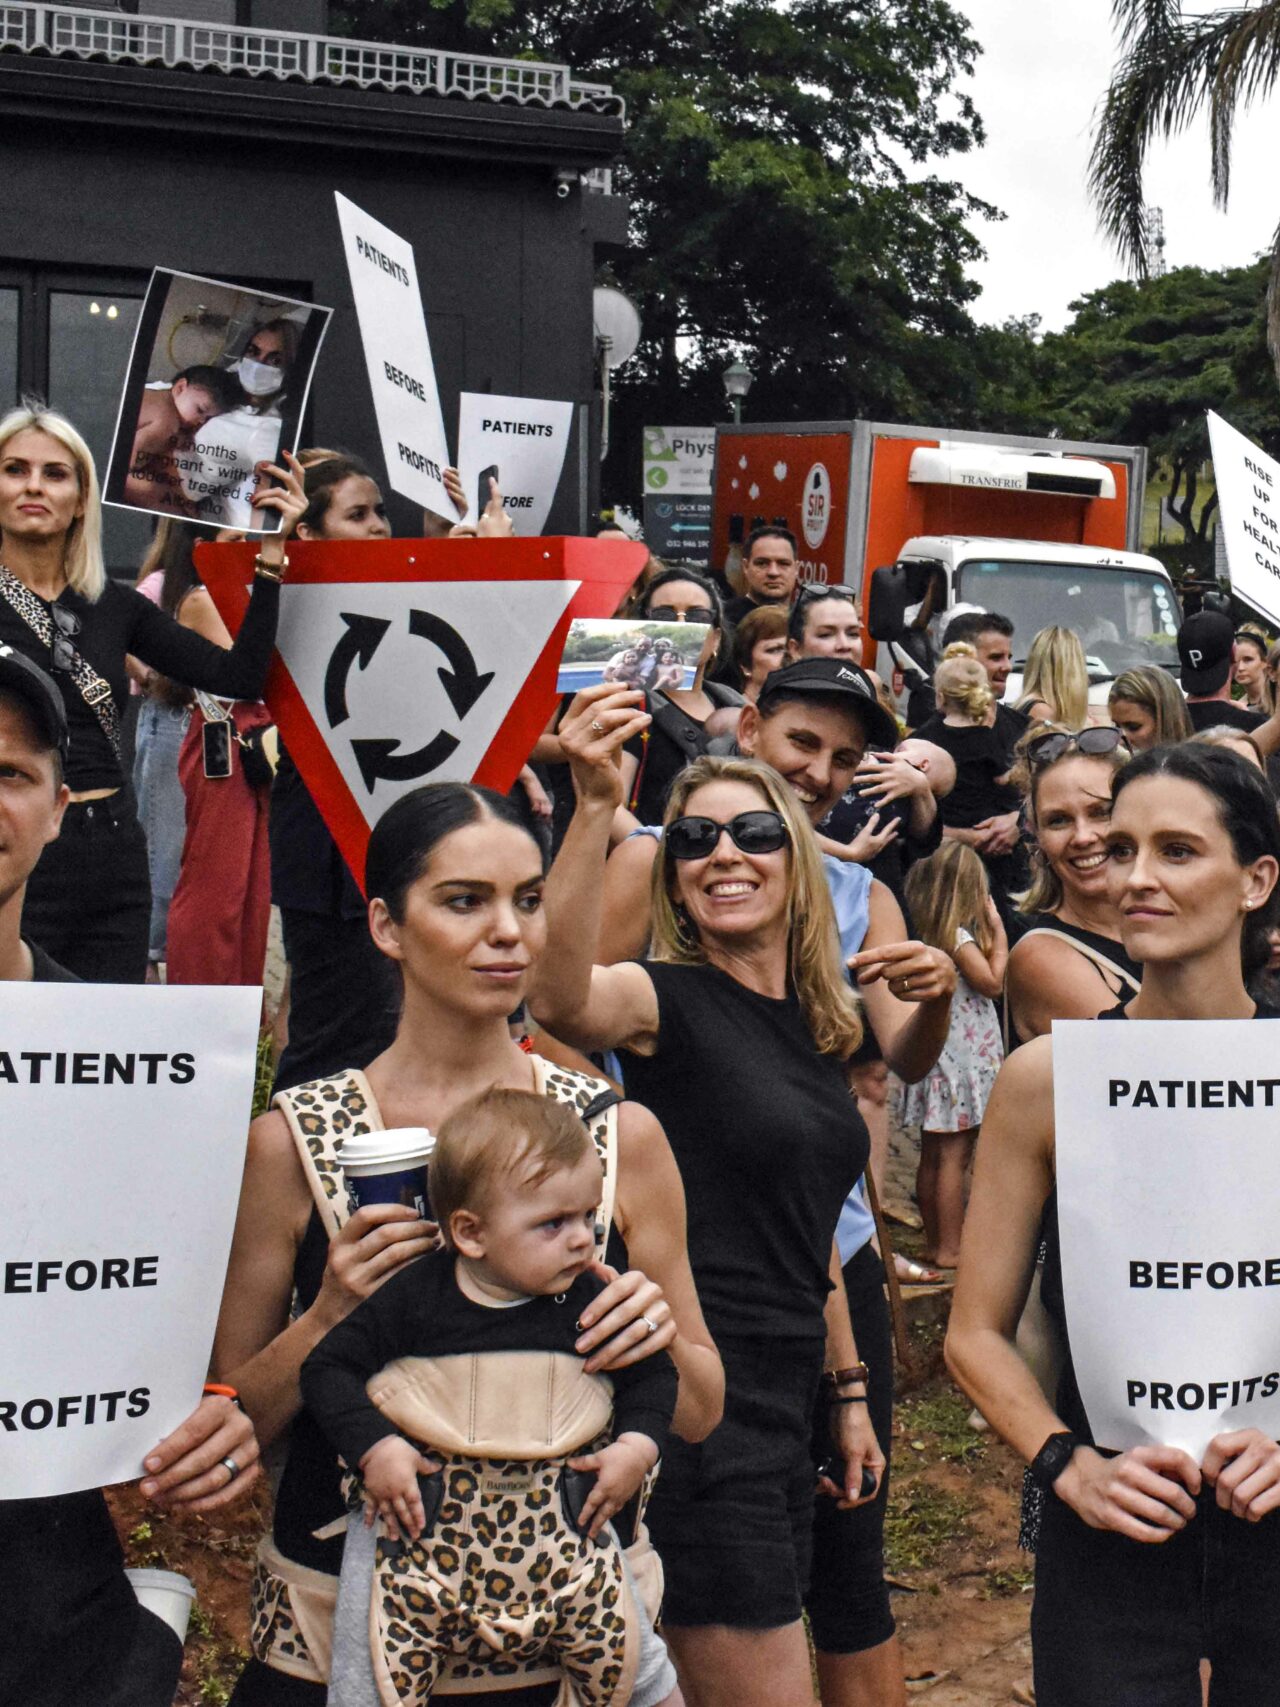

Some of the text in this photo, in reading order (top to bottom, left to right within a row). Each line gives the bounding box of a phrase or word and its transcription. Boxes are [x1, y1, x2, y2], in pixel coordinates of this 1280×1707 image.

[356, 235, 410, 287] PATIENTS
[384, 361, 426, 402] BEFORE
[482, 420, 553, 437] PATIENTS
[398, 441, 442, 482] PROFITS
[1243, 456, 1274, 488] RISE
[218, 466, 248, 481] with
[252, 474, 261, 485] a
[961, 475, 1022, 488] TRANSFRIG
[188, 479, 240, 500] treated
[1253, 484, 1270, 504] UP
[502, 496, 534, 508] FORE
[808, 494, 824, 517] SIR
[1252, 506, 1278, 534] FOR
[798, 561, 828, 584] COLD
[1189, 650, 1202, 668] P
[1126, 1372, 1280, 1411] PROFITS
